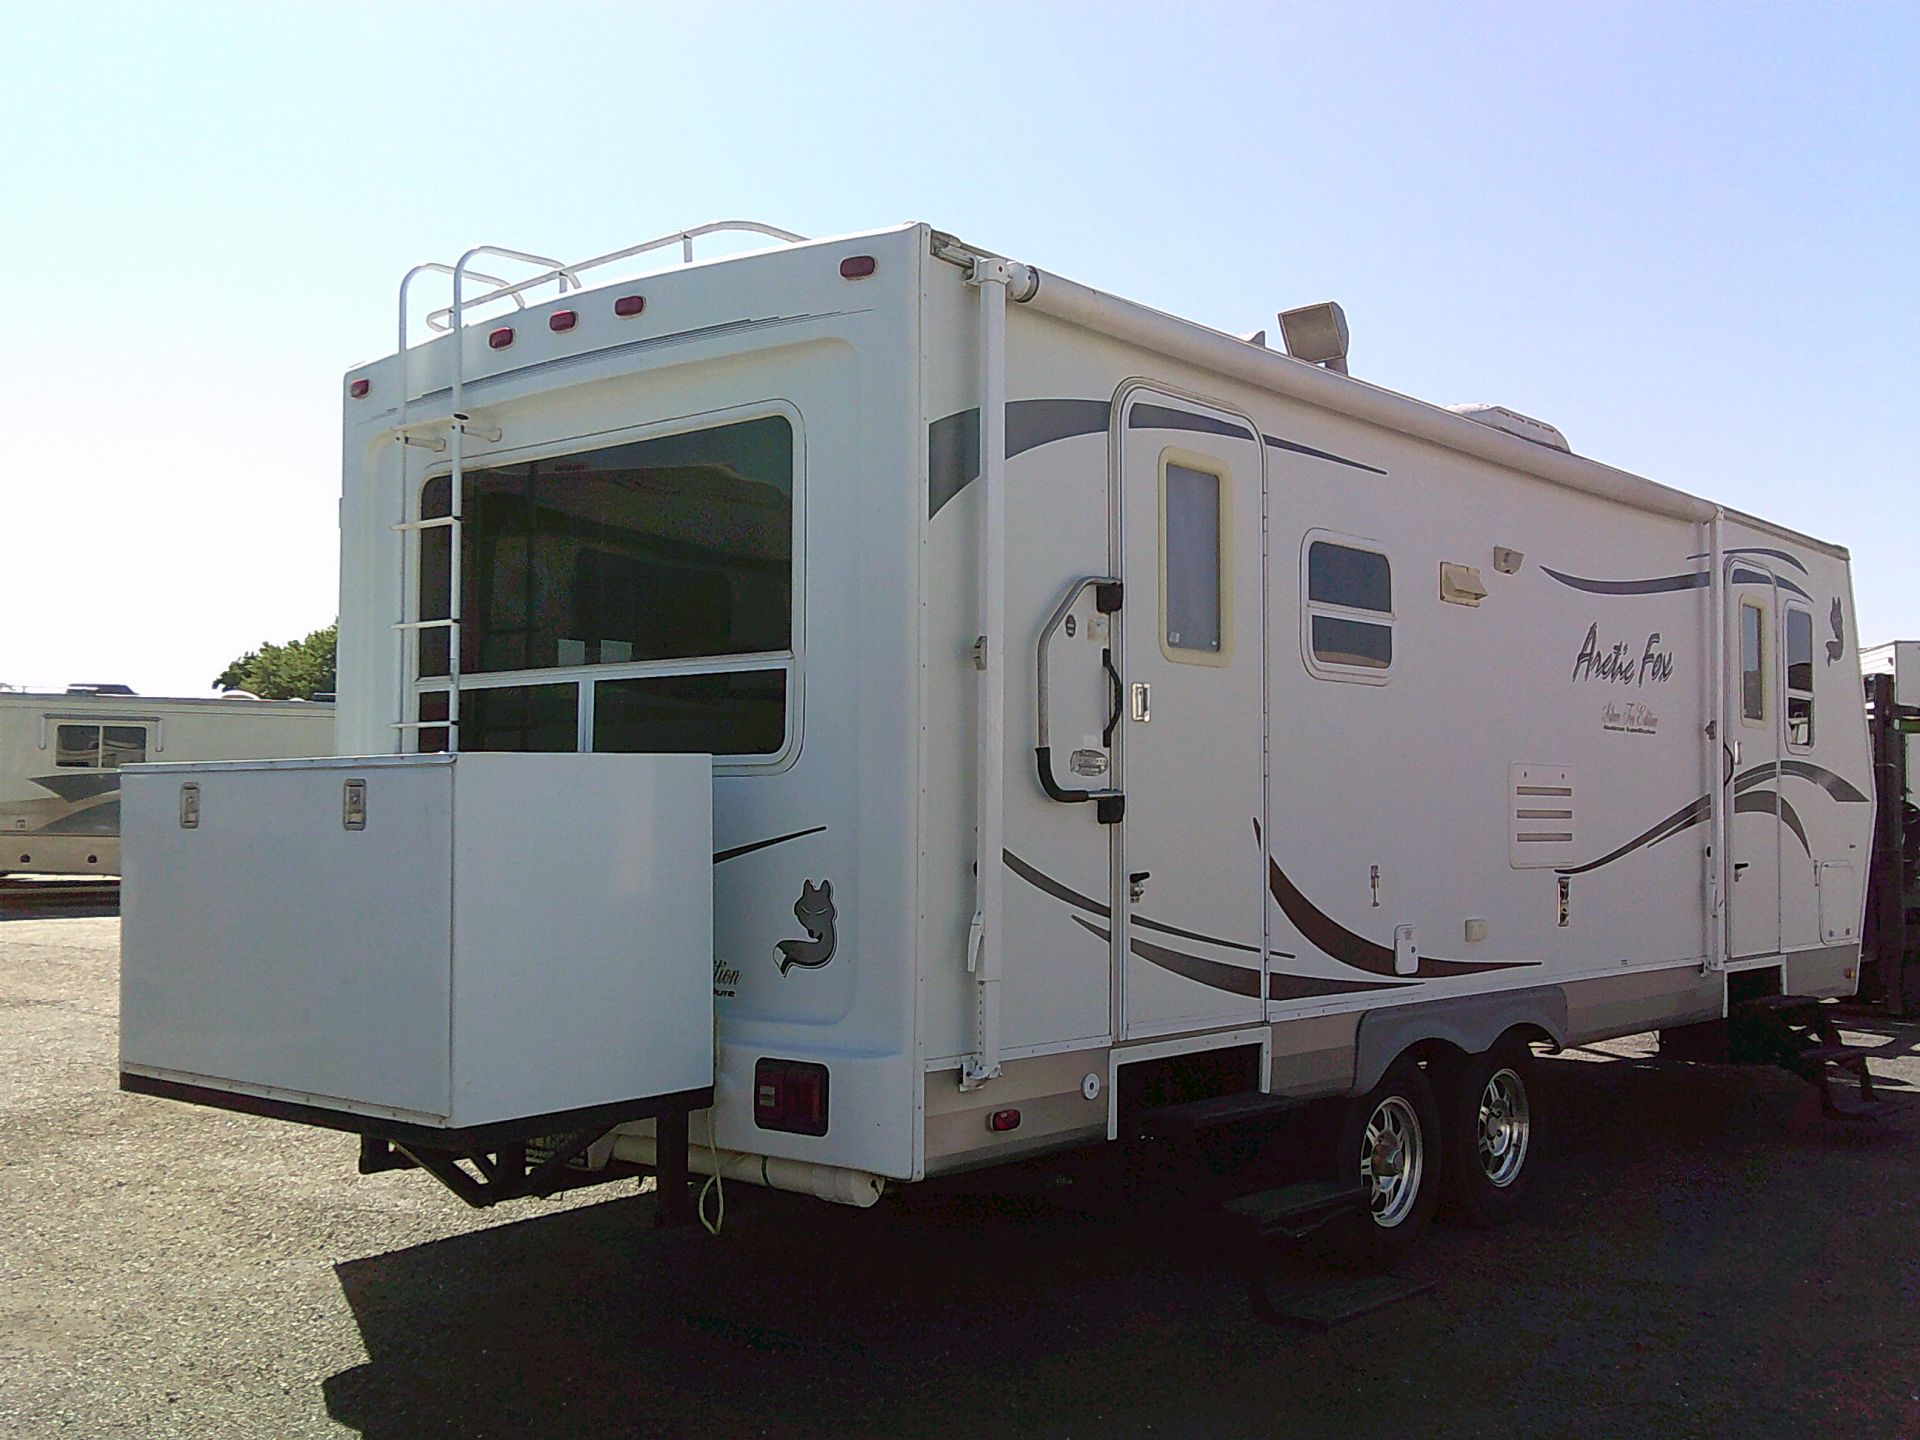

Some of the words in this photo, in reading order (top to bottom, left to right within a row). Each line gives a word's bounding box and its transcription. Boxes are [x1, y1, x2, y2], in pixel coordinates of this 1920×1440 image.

[1572, 621, 1635, 685] Arctic
[1638, 633, 1674, 688] Fox
[714, 960, 741, 985] tion
